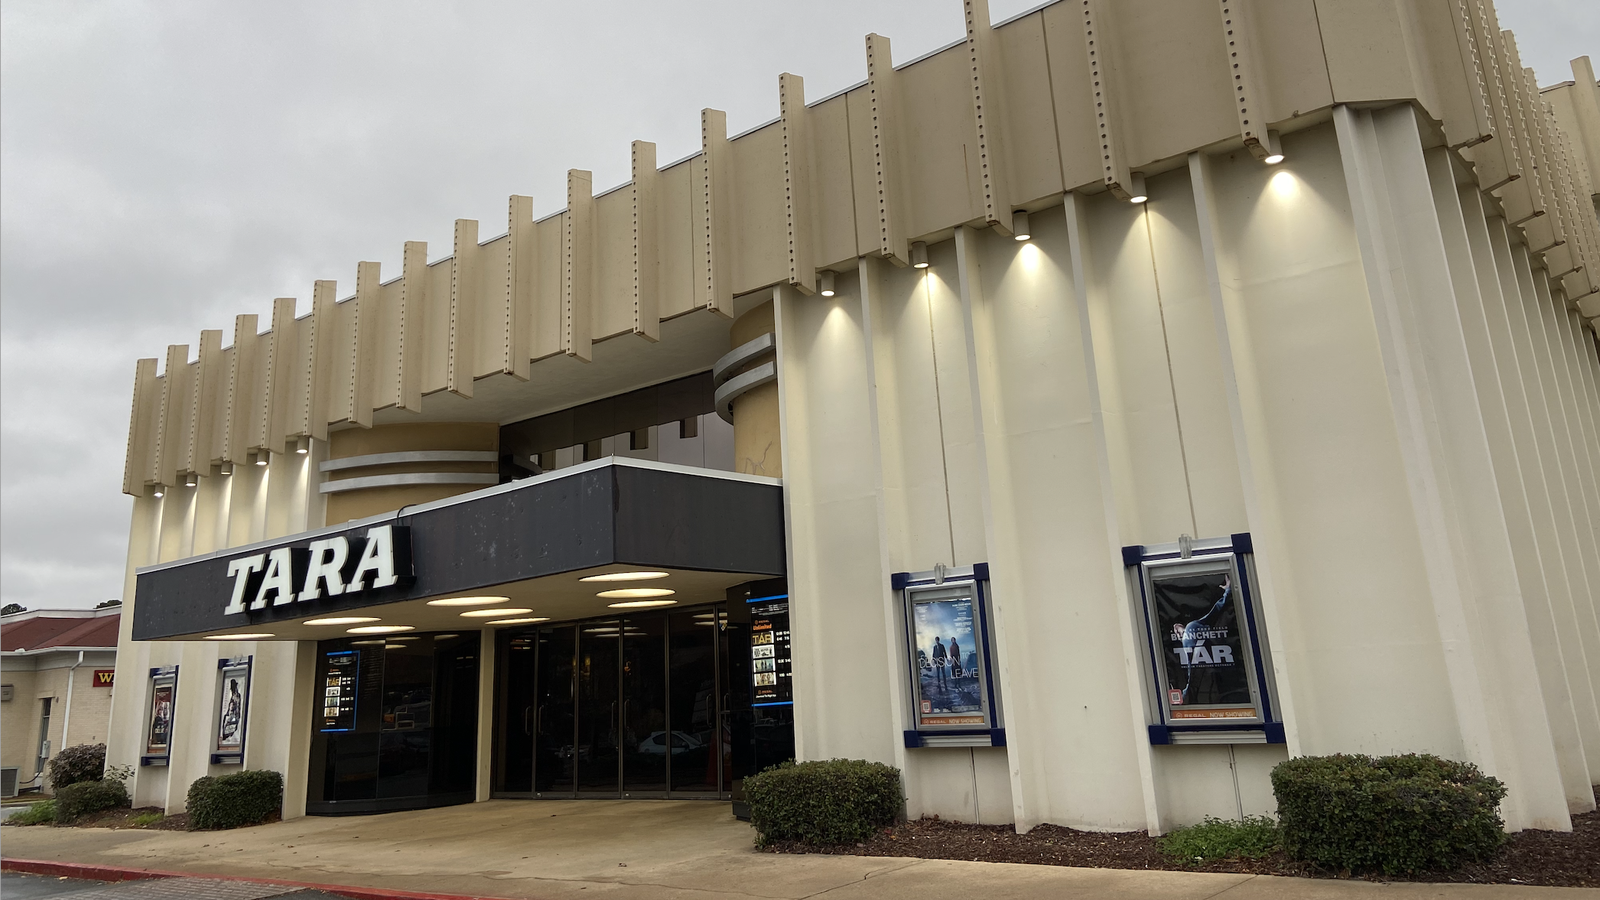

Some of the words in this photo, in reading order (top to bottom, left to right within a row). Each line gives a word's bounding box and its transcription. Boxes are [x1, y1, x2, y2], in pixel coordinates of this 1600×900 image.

[224, 524, 398, 615] TARA
[1170, 630, 1229, 641] BLANCHETT
[1173, 640, 1235, 665] TÁR
[919, 655, 961, 669] DECISION
[950, 668, 979, 679] LEAVE
